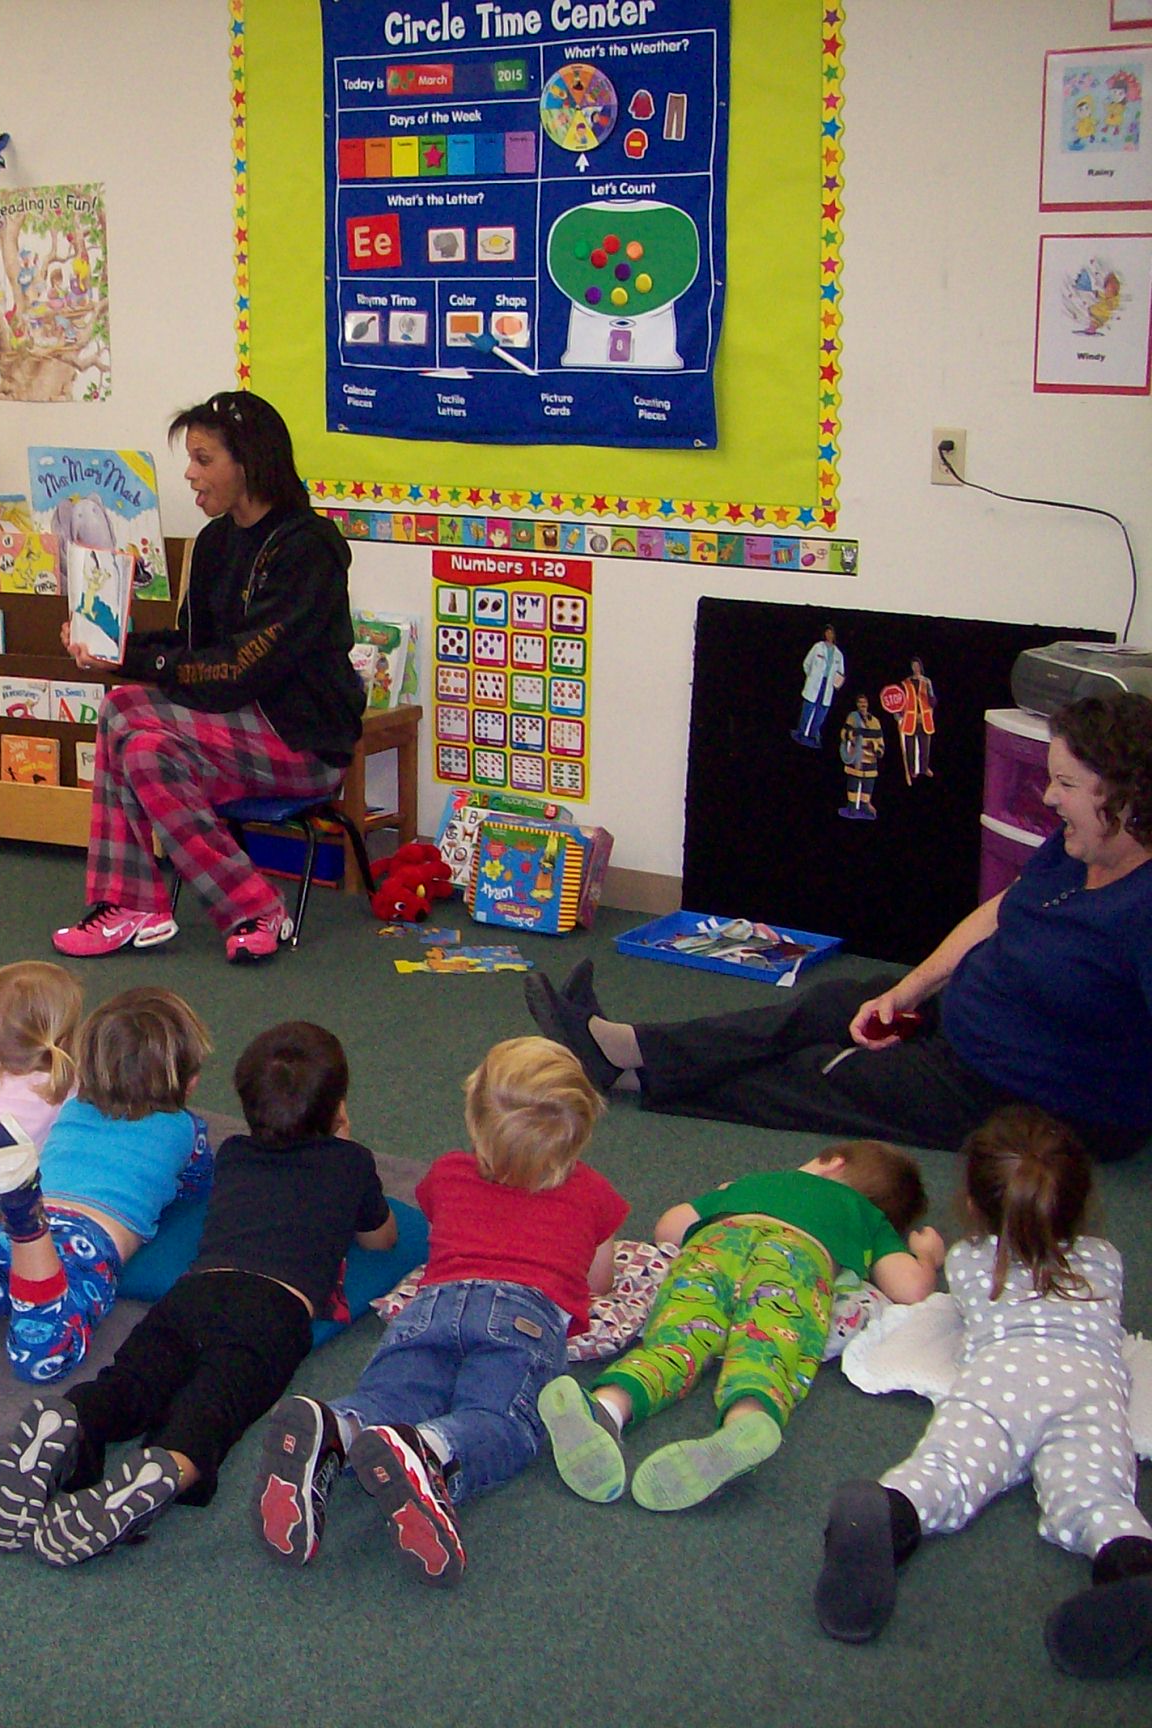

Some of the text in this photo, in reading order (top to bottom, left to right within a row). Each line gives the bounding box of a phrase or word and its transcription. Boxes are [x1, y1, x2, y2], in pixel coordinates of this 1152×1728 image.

[384, 0, 656, 45] Circle Time Center
[564, 38, 689, 60] What's the Weather?
[418, 74, 448, 87] March
[497, 69, 523, 82] 2015
[342, 76, 385, 93] Today is
[389, 110, 482, 128] Days of the Week
[591, 182, 656, 195] Let's Count
[49, 197, 61, 209] is
[66, 194, 97, 215] Fun!
[387, 193, 485, 206] What's the Letter?
[353, 226, 392, 258] Ee
[356, 294, 417, 308] Rhyme Time
[449, 294, 476, 307] Color
[495, 294, 527, 309] Shape
[616, 339, 624, 351] 8
[1077, 352, 1106, 362] Windy
[342, 383, 376, 397] Calendar
[347, 397, 373, 409] Pieces
[437, 393, 466, 405] Tactile
[540, 392, 574, 403] Picture
[633, 395, 671, 411] Counting
[437, 406, 467, 417] Letters
[544, 406, 571, 416] Cards
[638, 410, 667, 421] Pieces
[62, 455, 103, 486] Mary
[103, 458, 141, 507] Mack
[451, 555, 566, 578] Numbers 1-20
[883, 692, 903, 706] STOP
[468, 810, 479, 824] B
[480, 882, 514, 900] LORAX
